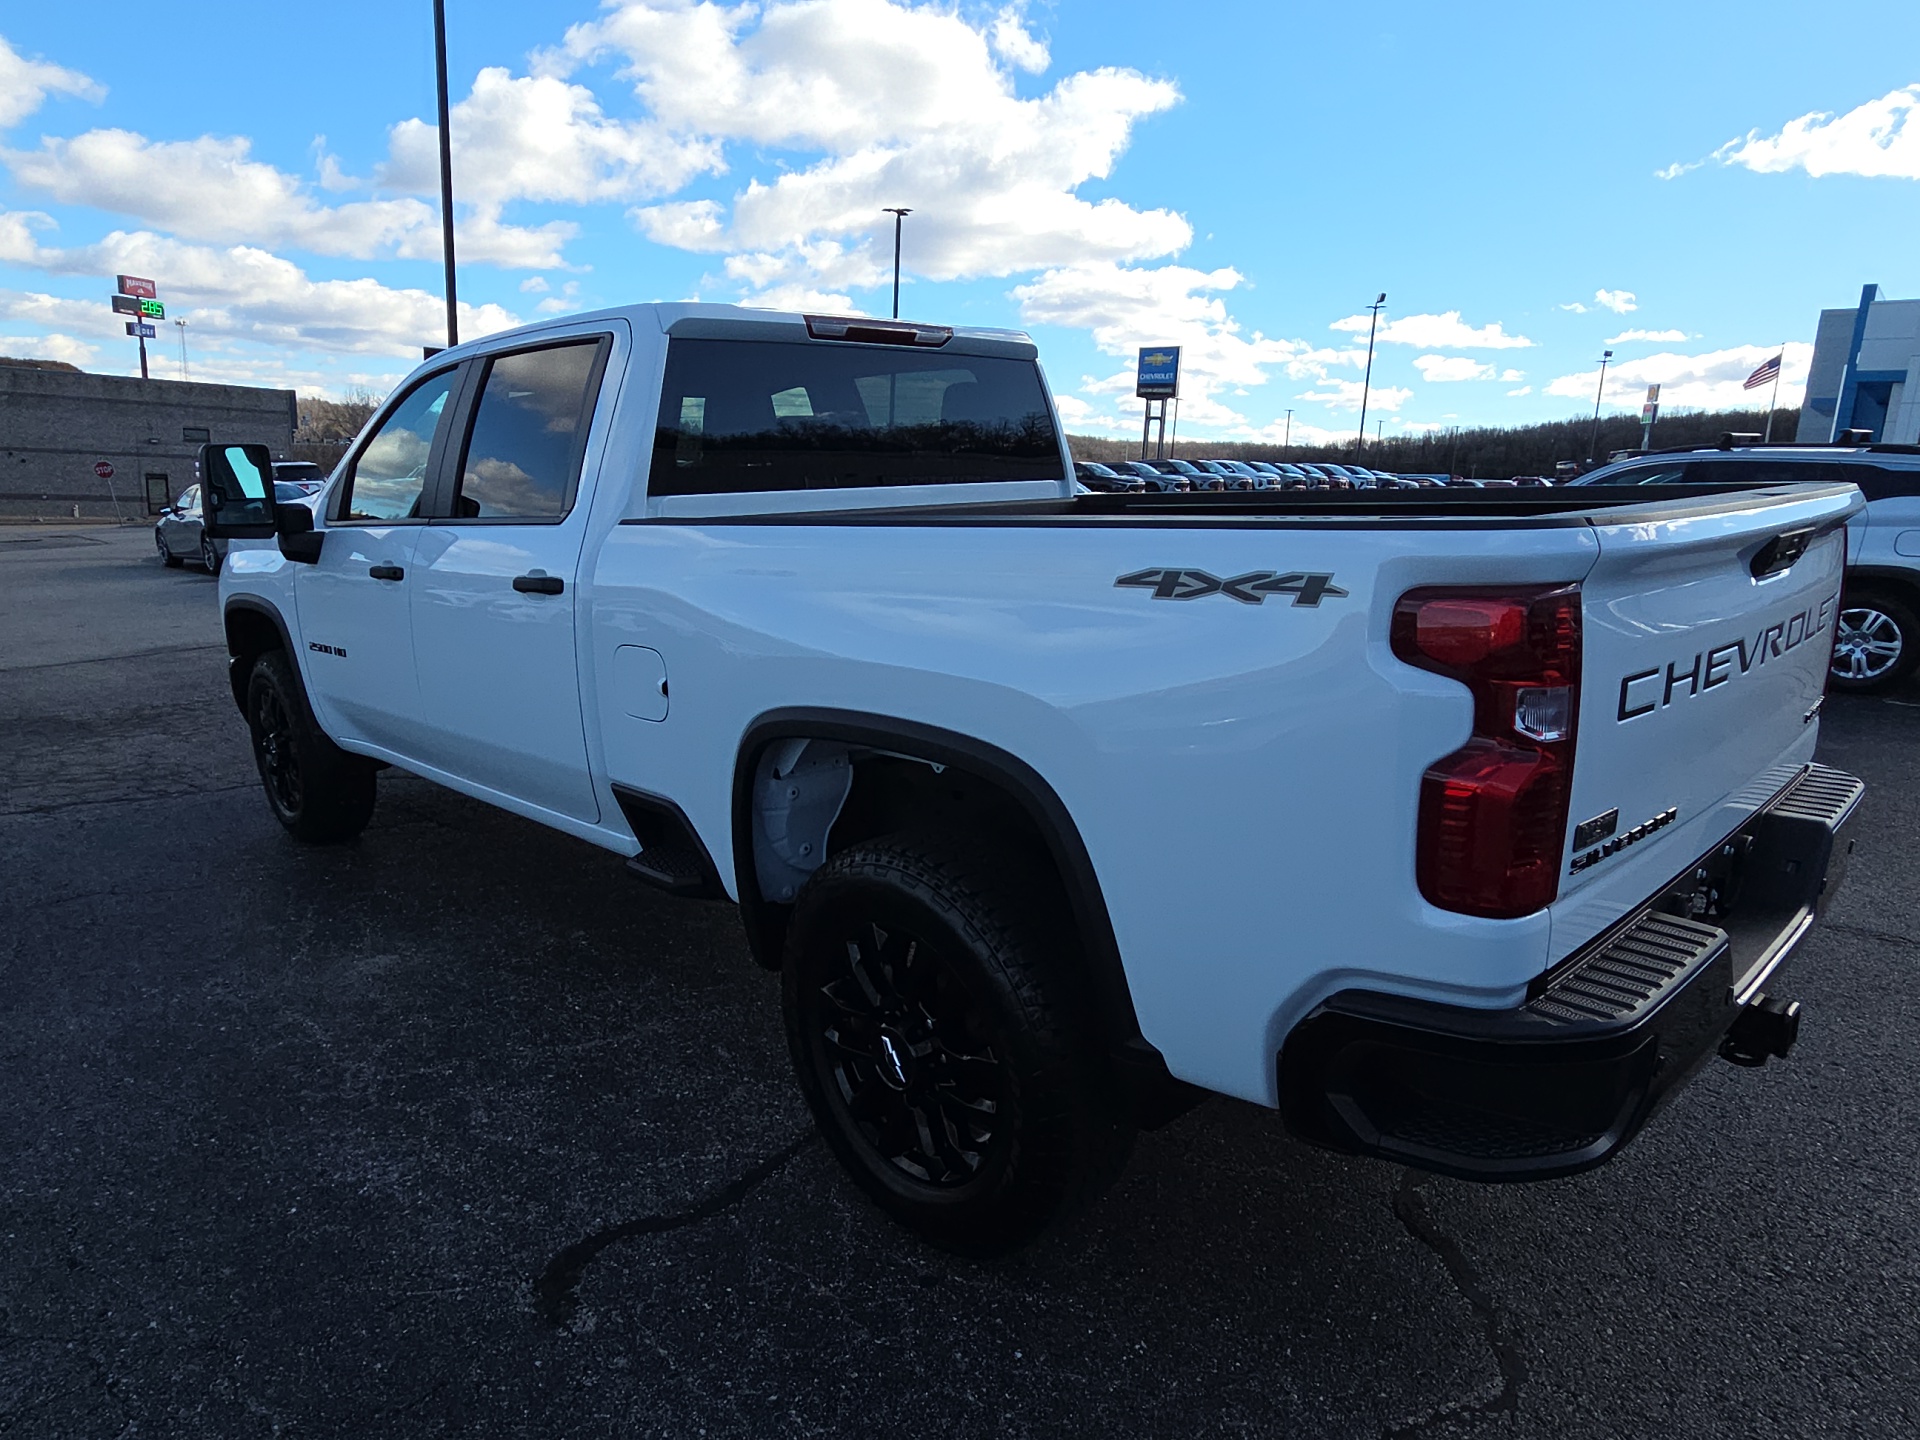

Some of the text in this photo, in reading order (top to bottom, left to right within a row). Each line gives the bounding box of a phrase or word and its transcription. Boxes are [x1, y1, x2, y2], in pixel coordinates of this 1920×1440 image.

[1140, 372, 1173, 380] CHEVROLET
[95, 465, 112, 474] STOP
[309, 642, 347, 657] 2500 HD
[1617, 592, 1838, 722] CHEVROLET
